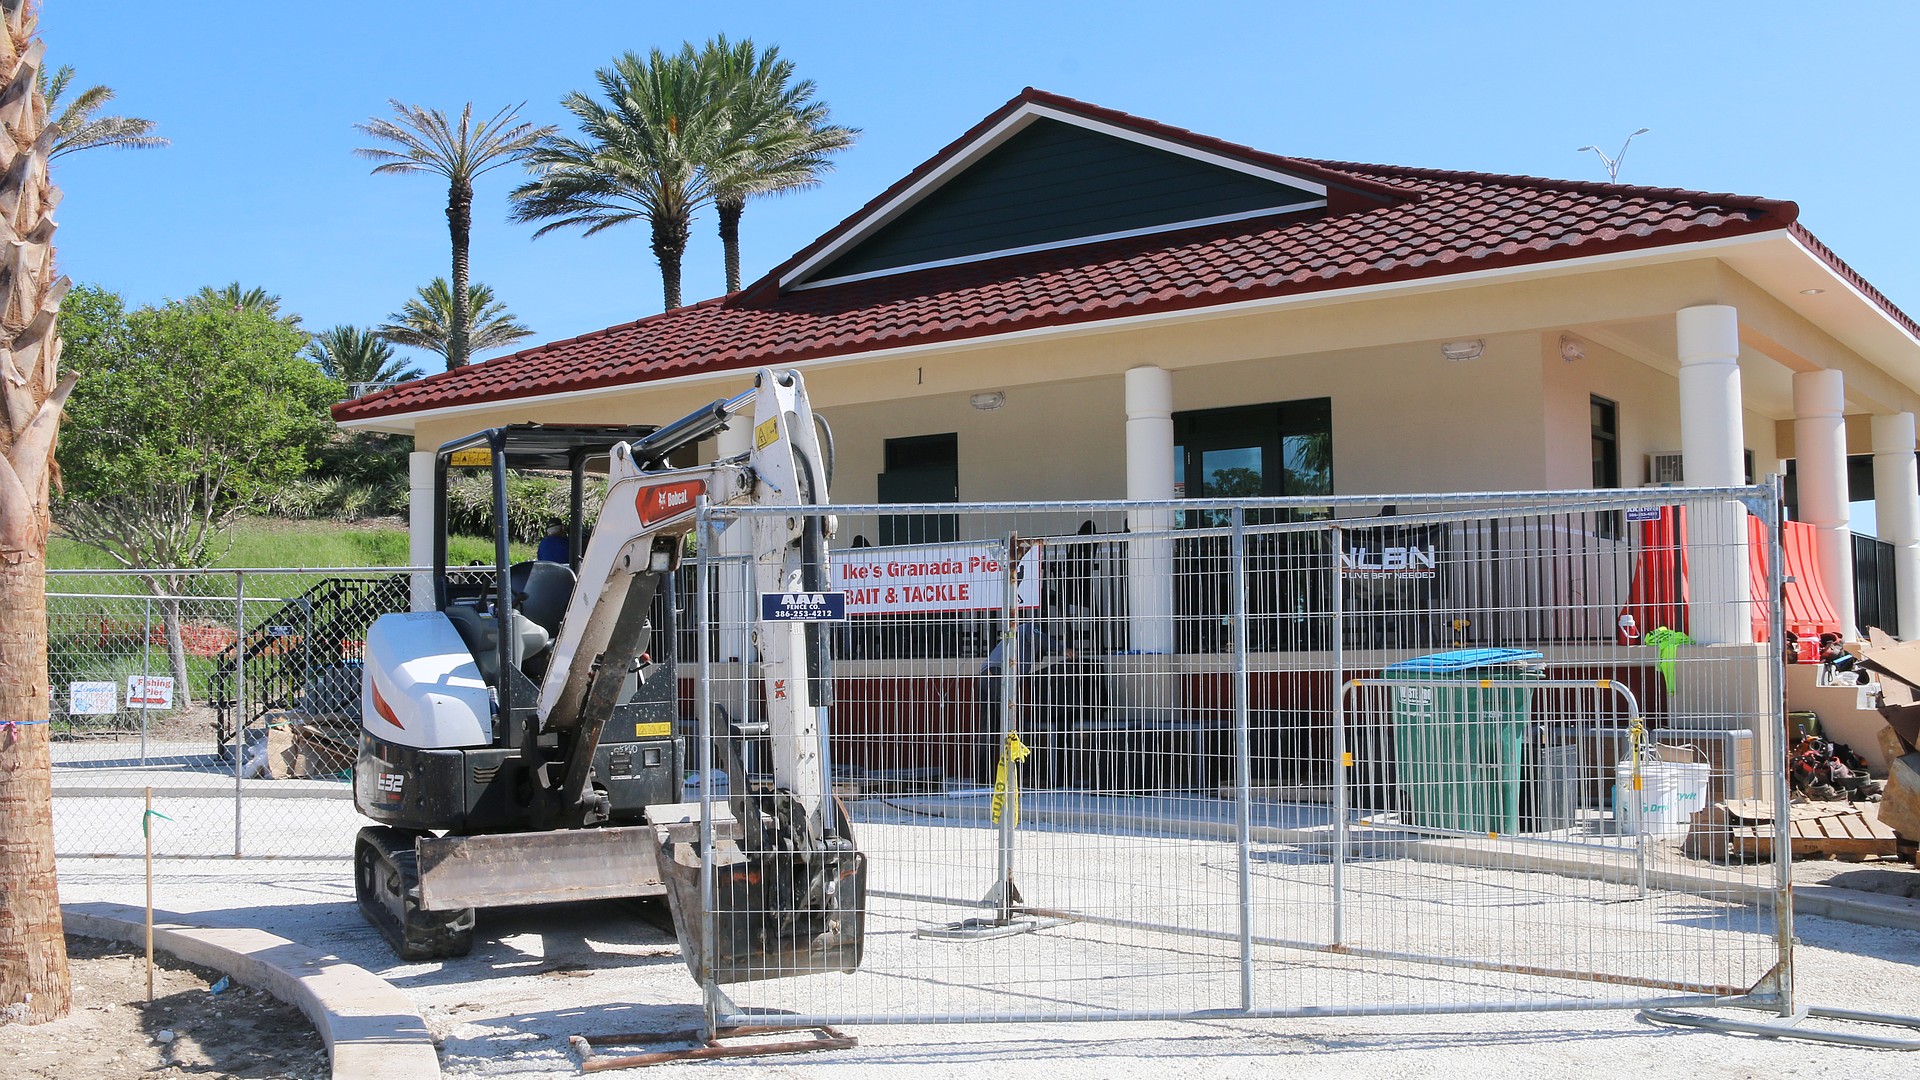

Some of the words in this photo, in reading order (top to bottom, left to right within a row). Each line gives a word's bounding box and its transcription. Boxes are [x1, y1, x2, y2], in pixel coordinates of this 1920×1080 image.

[667, 489, 688, 507] Bobcat
[843, 562, 883, 580] Ike's
[887, 556, 963, 577] Granada
[1372, 571, 1393, 580] BAIT
[1394, 571, 1436, 579] NEEDED
[780, 594, 827, 605] AAA
[844, 588, 880, 606] BAIT
[885, 586, 899, 604] &
[903, 583, 969, 603] TACKLE
[775, 610, 832, 618] 386-253-4212
[137, 678, 171, 689] Fshing
[377, 772, 405, 793] E32
